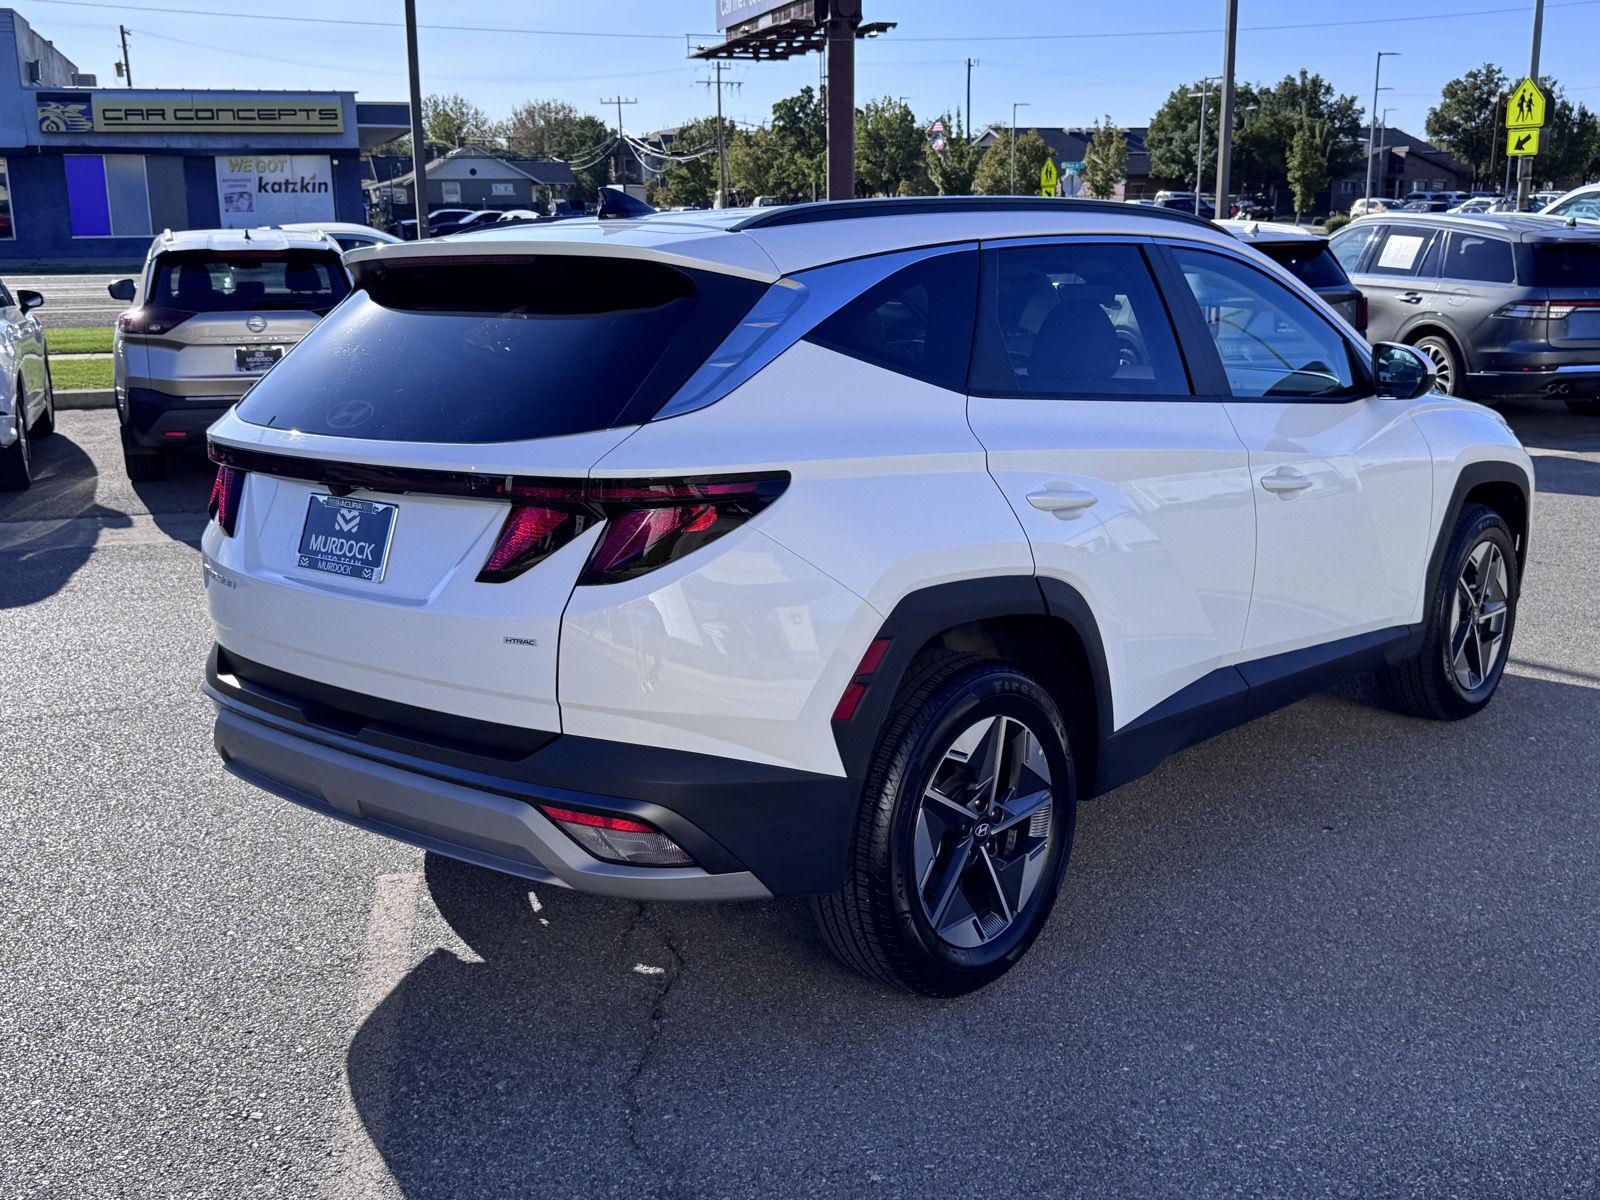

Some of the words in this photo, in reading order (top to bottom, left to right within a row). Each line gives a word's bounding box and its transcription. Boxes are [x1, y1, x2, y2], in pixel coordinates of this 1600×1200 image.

[102, 108, 167, 121] CAR
[173, 108, 339, 121] CONCEPTS
[228, 158, 252, 173] WE
[256, 158, 288, 174] GOT
[257, 175, 329, 193] katzkin
[309, 533, 376, 561] MURDOCK
[317, 560, 353, 575] MURDOCK
[505, 638, 535, 646] HTRAC
